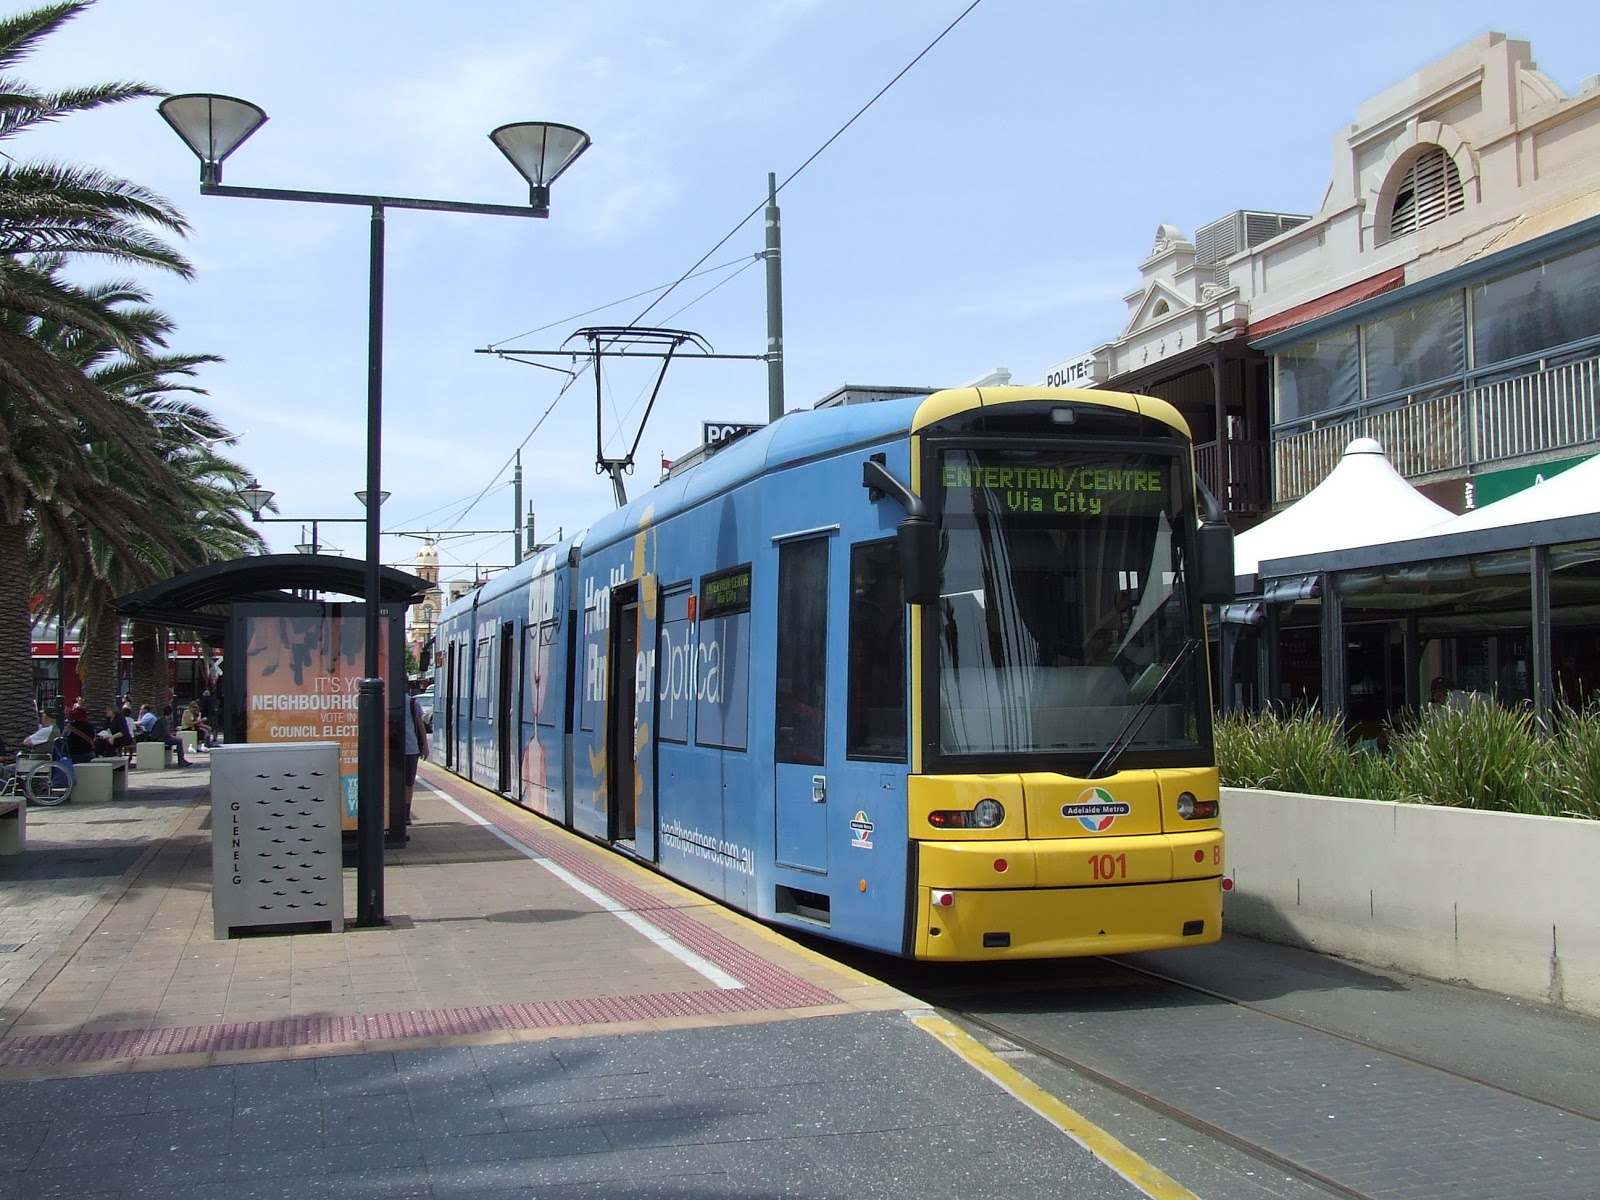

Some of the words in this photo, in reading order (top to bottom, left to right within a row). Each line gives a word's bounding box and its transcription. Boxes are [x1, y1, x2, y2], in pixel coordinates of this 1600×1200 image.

[1007, 491, 1043, 512] Via
[1053, 492, 1102, 514] City
[315, 677, 341, 693] IT'S
[344, 677, 362, 693] YO
[252, 694, 359, 711] NEIGHBOURHO
[320, 712, 345, 723] VOTE
[346, 713, 356, 722] IN
[270, 725, 319, 738] COUNCIL
[323, 725, 359, 737] ELECT
[1068, 806, 1101, 814] Adelaide
[1102, 805, 1125, 813] Metro
[230, 801, 242, 885] GLENELG
[1213, 845, 1221, 865] B
[1088, 853, 1127, 880] 101
